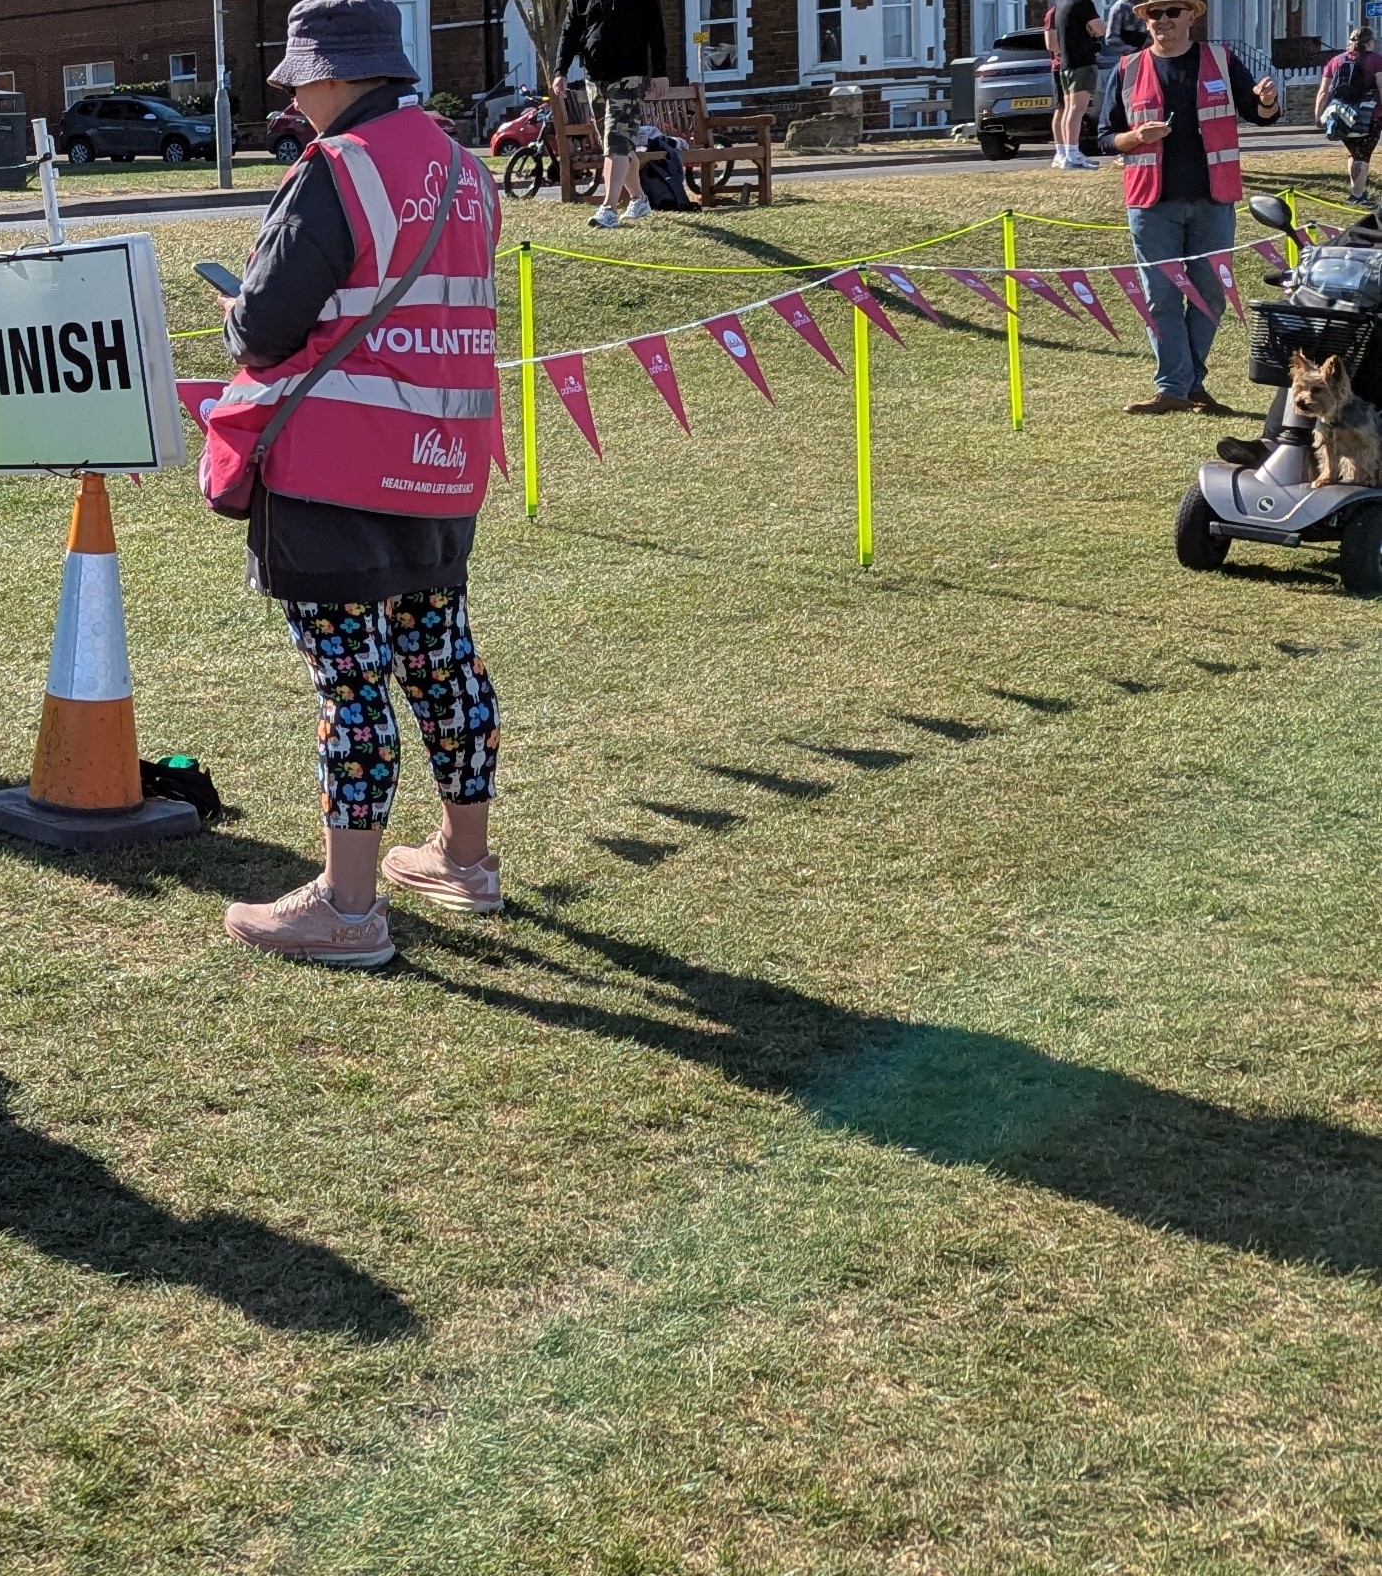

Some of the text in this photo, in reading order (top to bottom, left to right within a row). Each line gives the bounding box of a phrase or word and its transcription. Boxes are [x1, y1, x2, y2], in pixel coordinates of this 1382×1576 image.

[398, 196, 483, 230] paun
[365, 327, 495, 355] VOLUNTEER
[412, 428, 467, 479] Vitality
[381, 477, 415, 491] HEALTH
